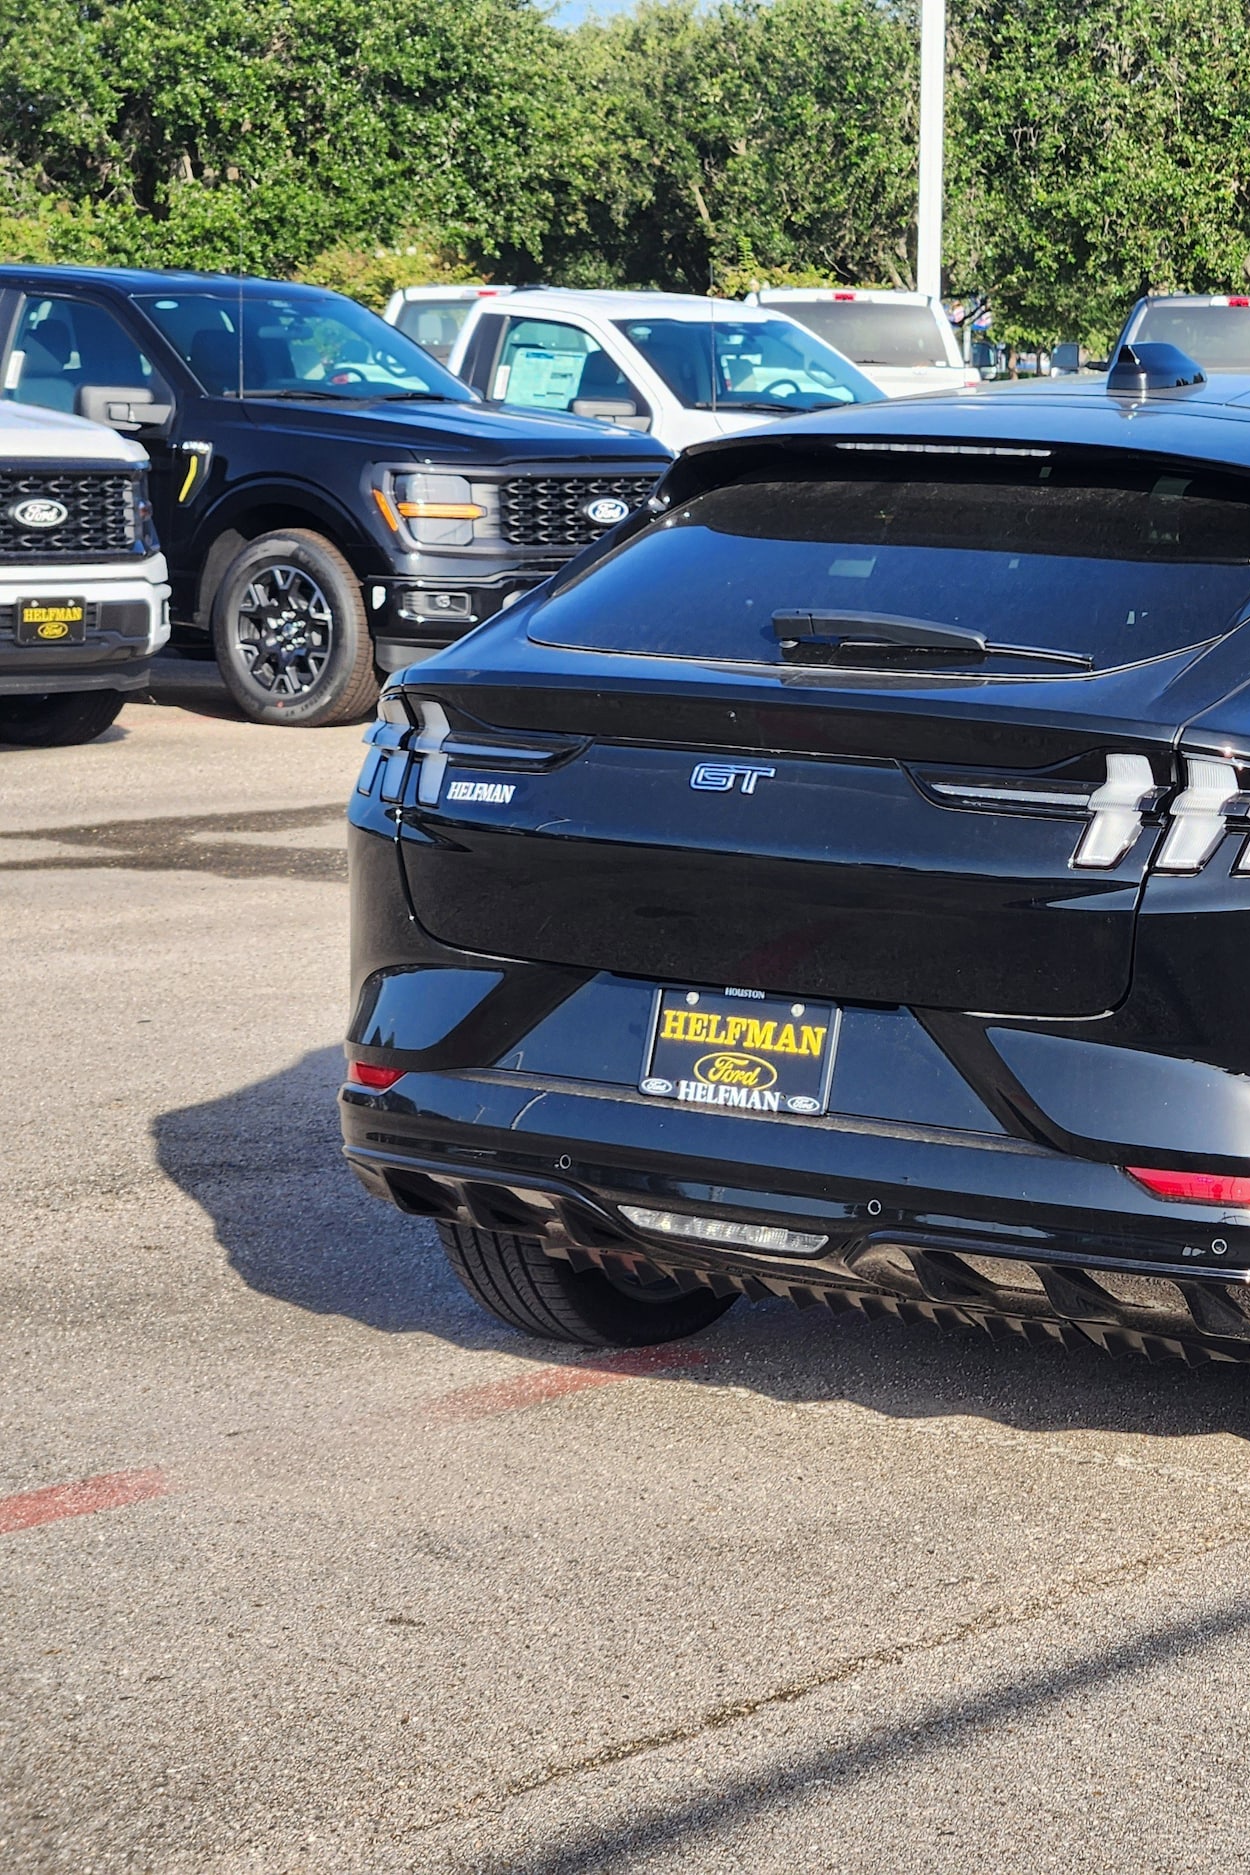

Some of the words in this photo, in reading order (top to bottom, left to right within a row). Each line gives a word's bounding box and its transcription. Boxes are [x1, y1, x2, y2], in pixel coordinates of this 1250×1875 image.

[22, 502, 61, 524] Ford
[23, 607, 82, 622] HELFMAN
[41, 624, 64, 637] Ford
[689, 762, 775, 794] GT
[446, 782, 516, 804] HELFMAN
[725, 987, 765, 1000] HOUSTON
[660, 1010, 827, 1056] HELFMAN
[708, 1055, 761, 1086] Ford
[677, 1080, 781, 1112] HELFMAN
